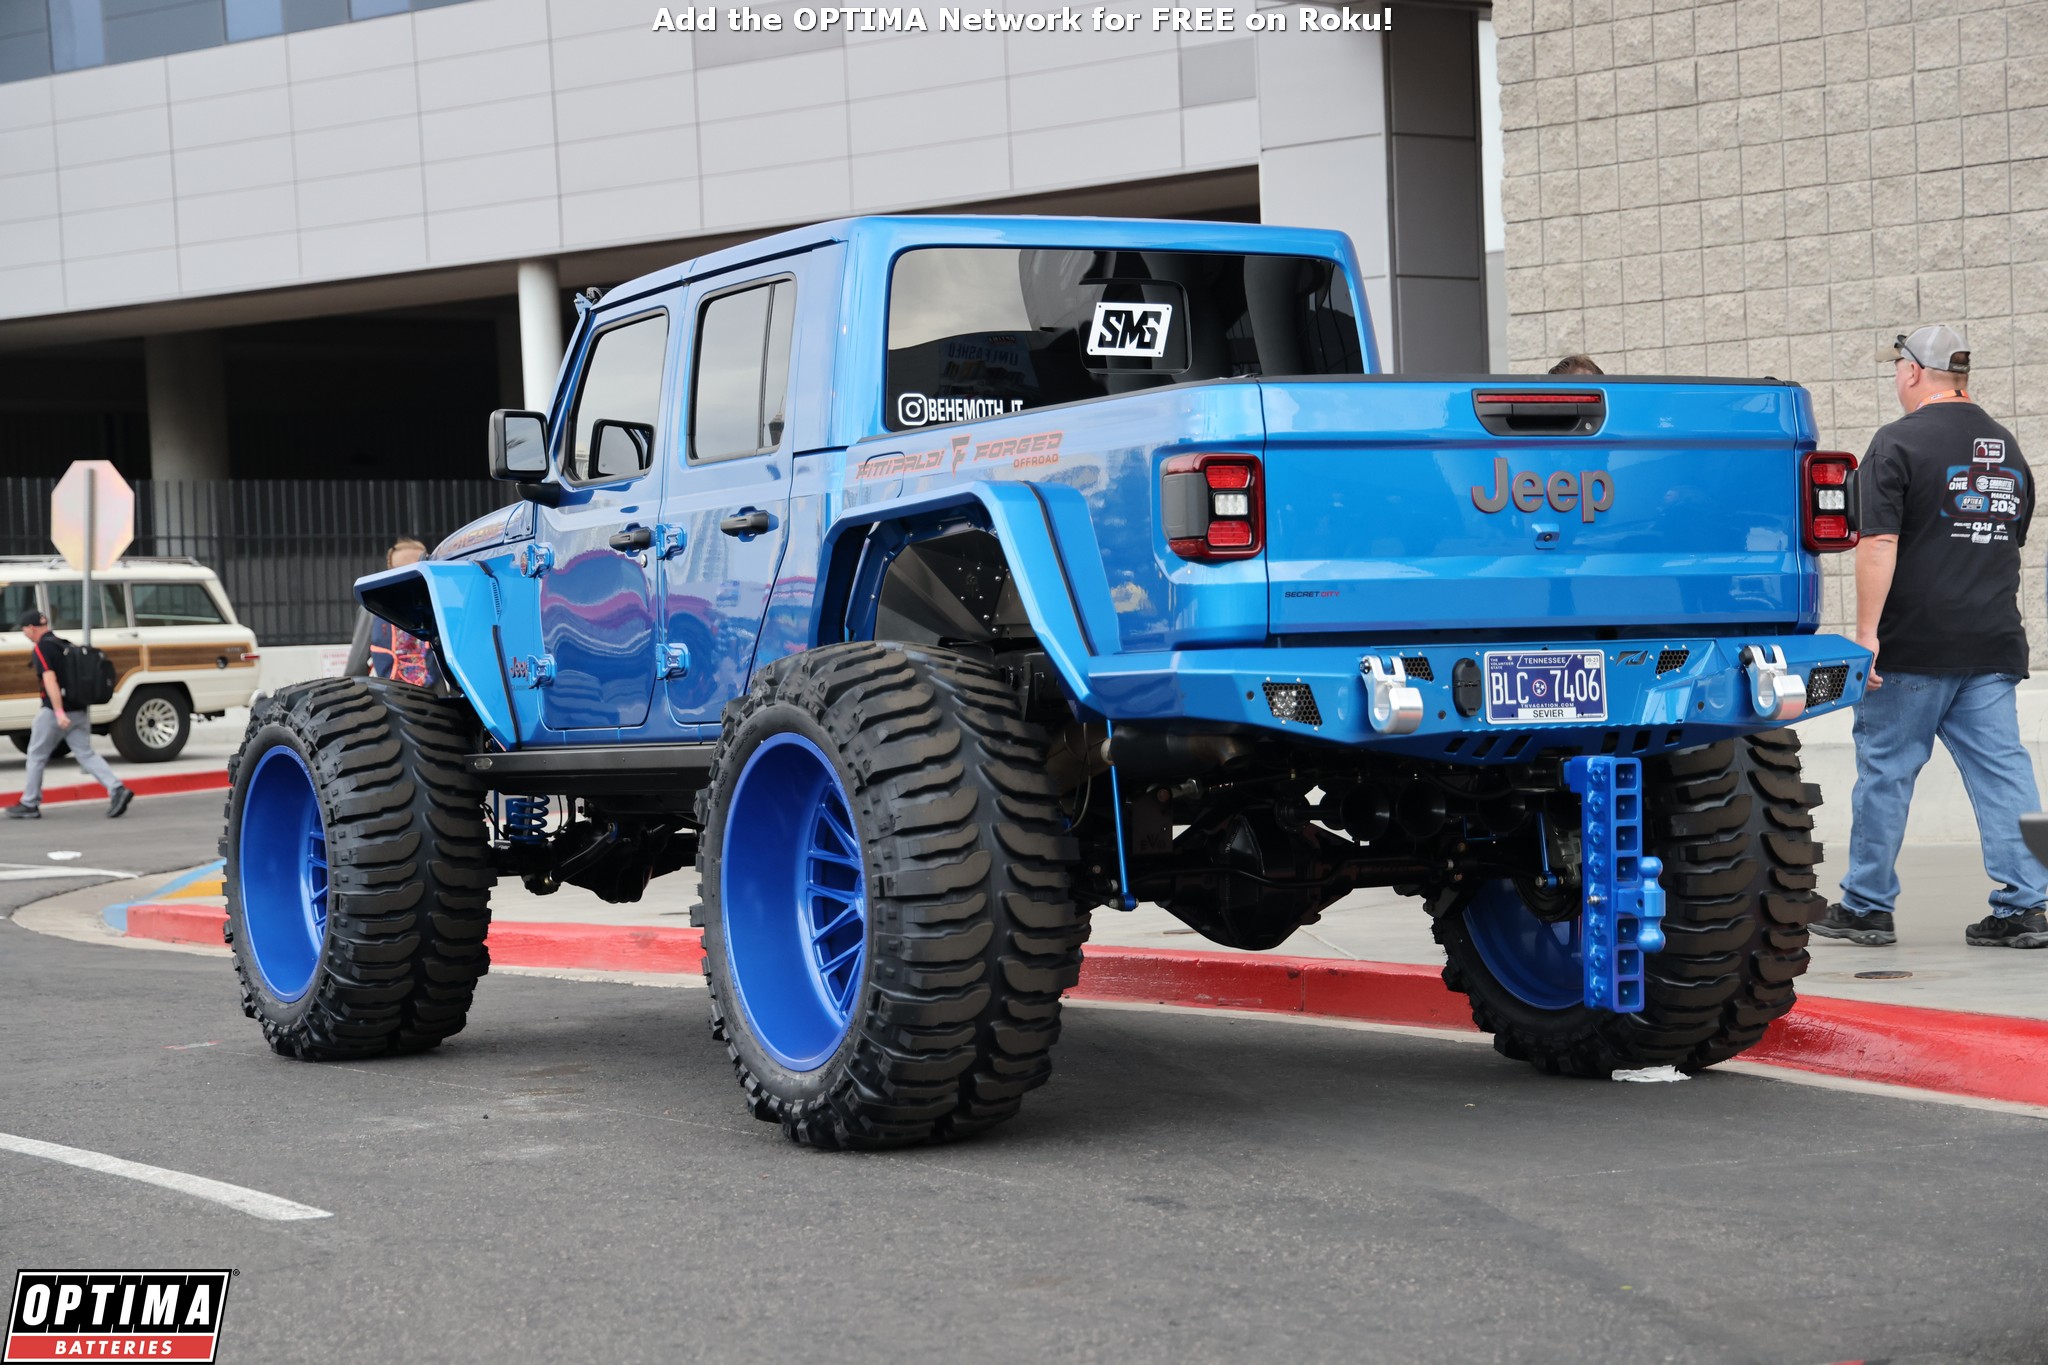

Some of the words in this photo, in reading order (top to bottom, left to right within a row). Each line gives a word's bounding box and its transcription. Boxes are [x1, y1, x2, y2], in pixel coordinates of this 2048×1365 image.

[973, 430, 1064, 461] FORGED
[1013, 453, 1059, 469] OFFROAD
[1471, 457, 1615, 523] Jeep
[1949, 481, 1968, 490] ONE
[1524, 656, 1567, 665] TENNESSEE
[1490, 671, 1530, 705] BLC
[1549, 669, 1600, 702] 7406
[1533, 709, 1564, 718] SEVIER
